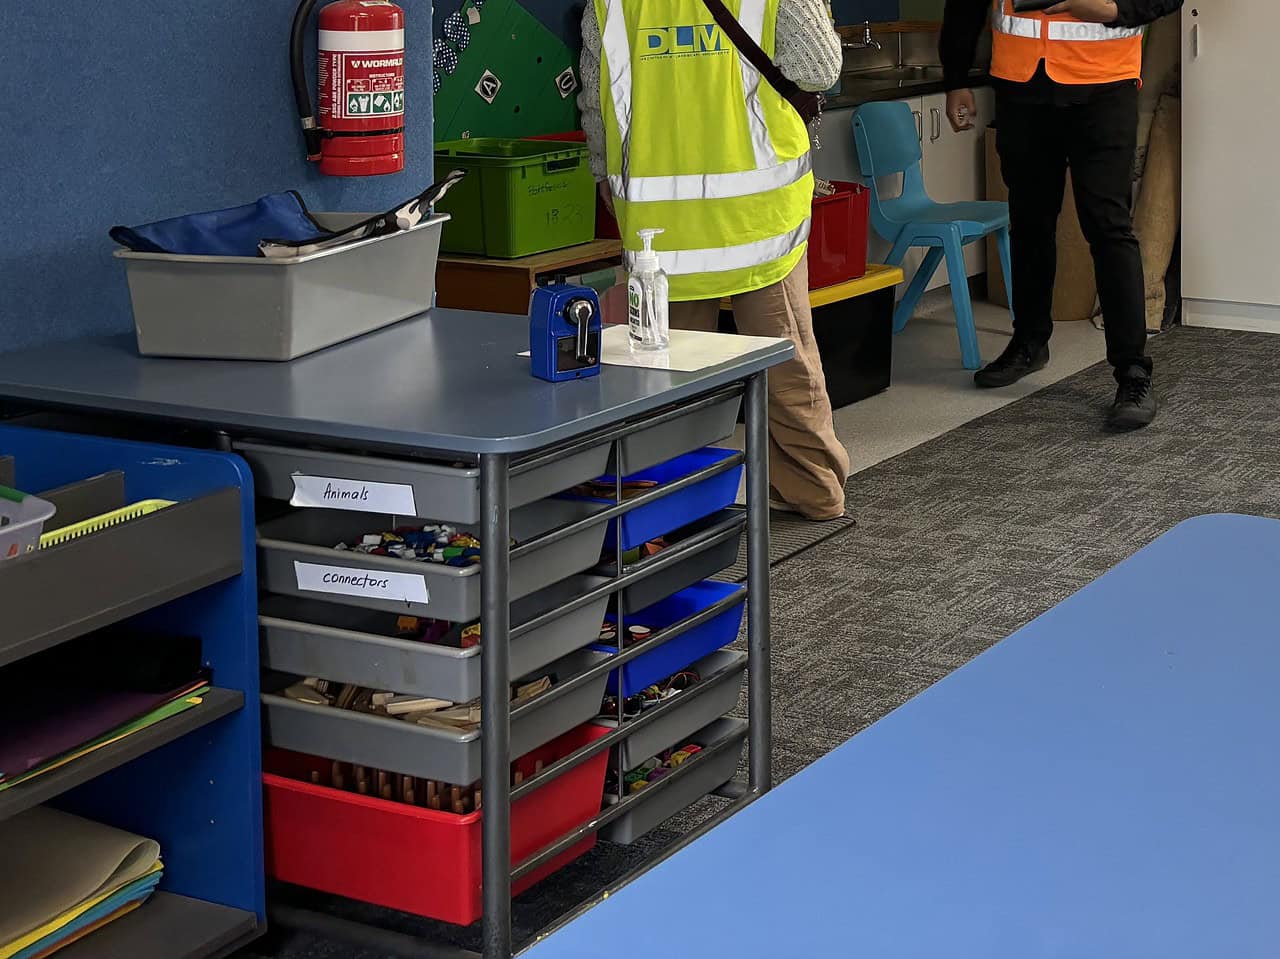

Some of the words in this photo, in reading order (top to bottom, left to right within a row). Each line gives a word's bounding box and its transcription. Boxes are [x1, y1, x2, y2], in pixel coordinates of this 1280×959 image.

[639, 24, 729, 54] DLM
[482, 80, 497, 95] A
[323, 482, 370, 501] Animals
